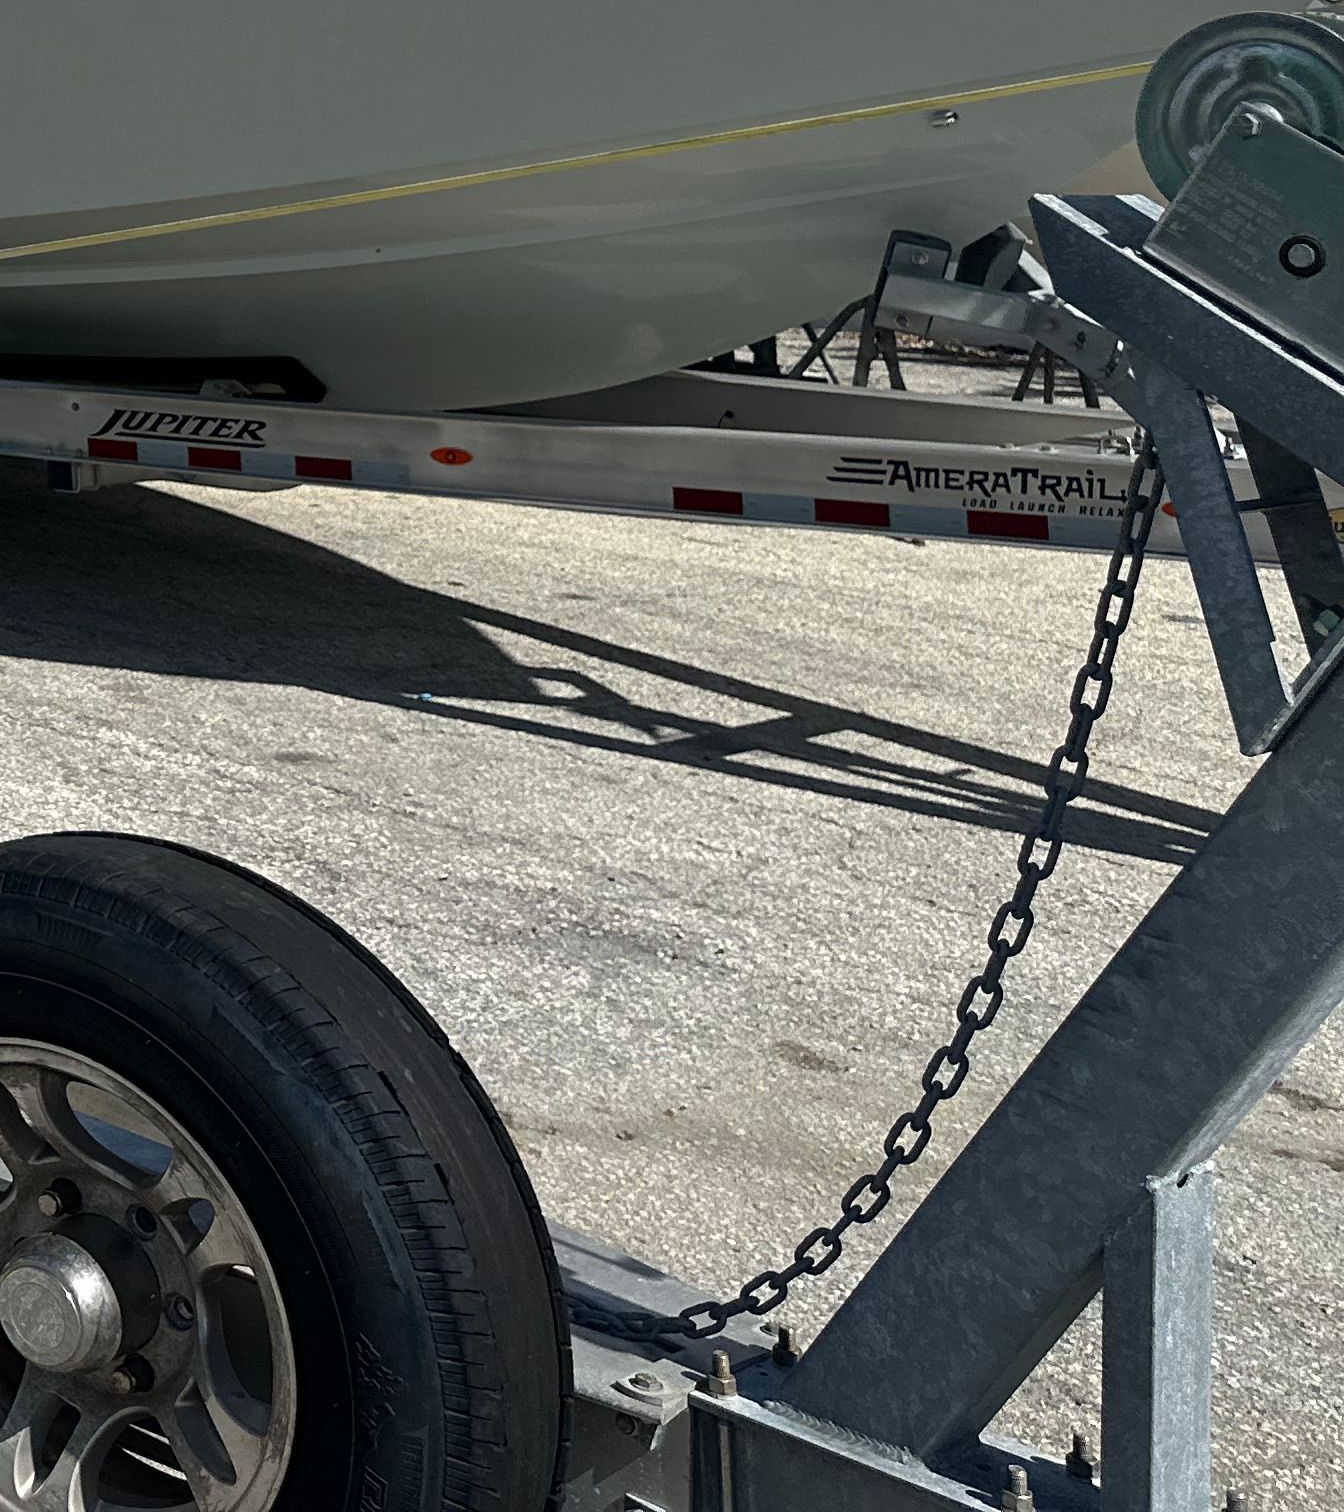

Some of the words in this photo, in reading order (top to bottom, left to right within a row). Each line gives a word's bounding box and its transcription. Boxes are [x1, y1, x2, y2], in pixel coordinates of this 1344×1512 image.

[89, 408, 268, 442] JUPITER
[962, 496, 998, 510] LOAD
[1009, 500, 1066, 515] LAUNCH
[1079, 504, 1126, 518] RELAX
